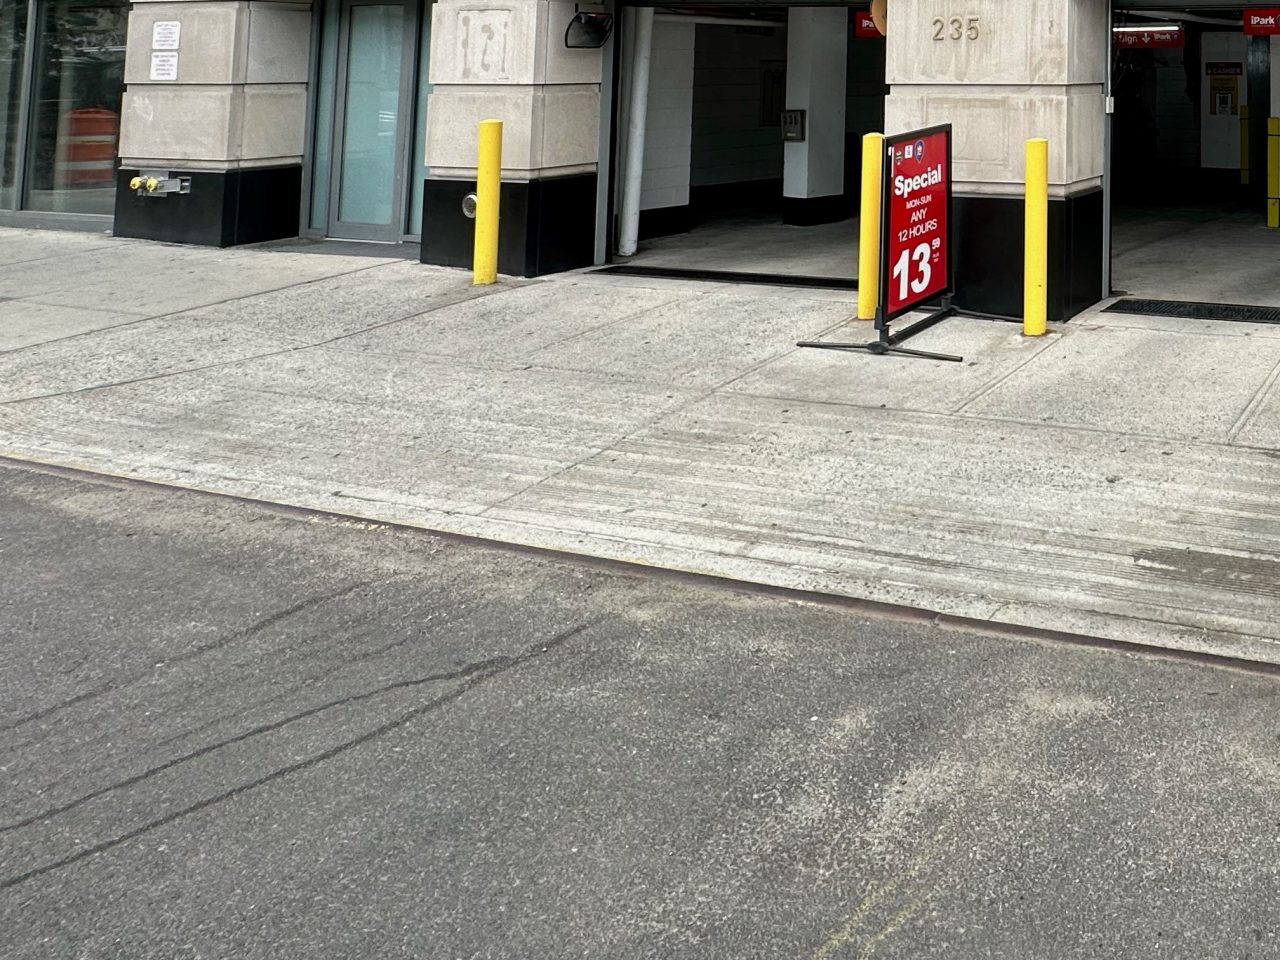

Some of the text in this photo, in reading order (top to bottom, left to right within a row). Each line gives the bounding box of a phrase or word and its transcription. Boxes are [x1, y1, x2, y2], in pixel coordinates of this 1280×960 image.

[932, 16, 979, 41] 235
[1250, 15, 1275, 25] iPark
[894, 163, 942, 198] Special
[905, 194, 932, 210] MON-SUN
[910, 207, 928, 223] ANY
[898, 218, 938, 242] 12 HOURS
[893, 242, 932, 301] 13
